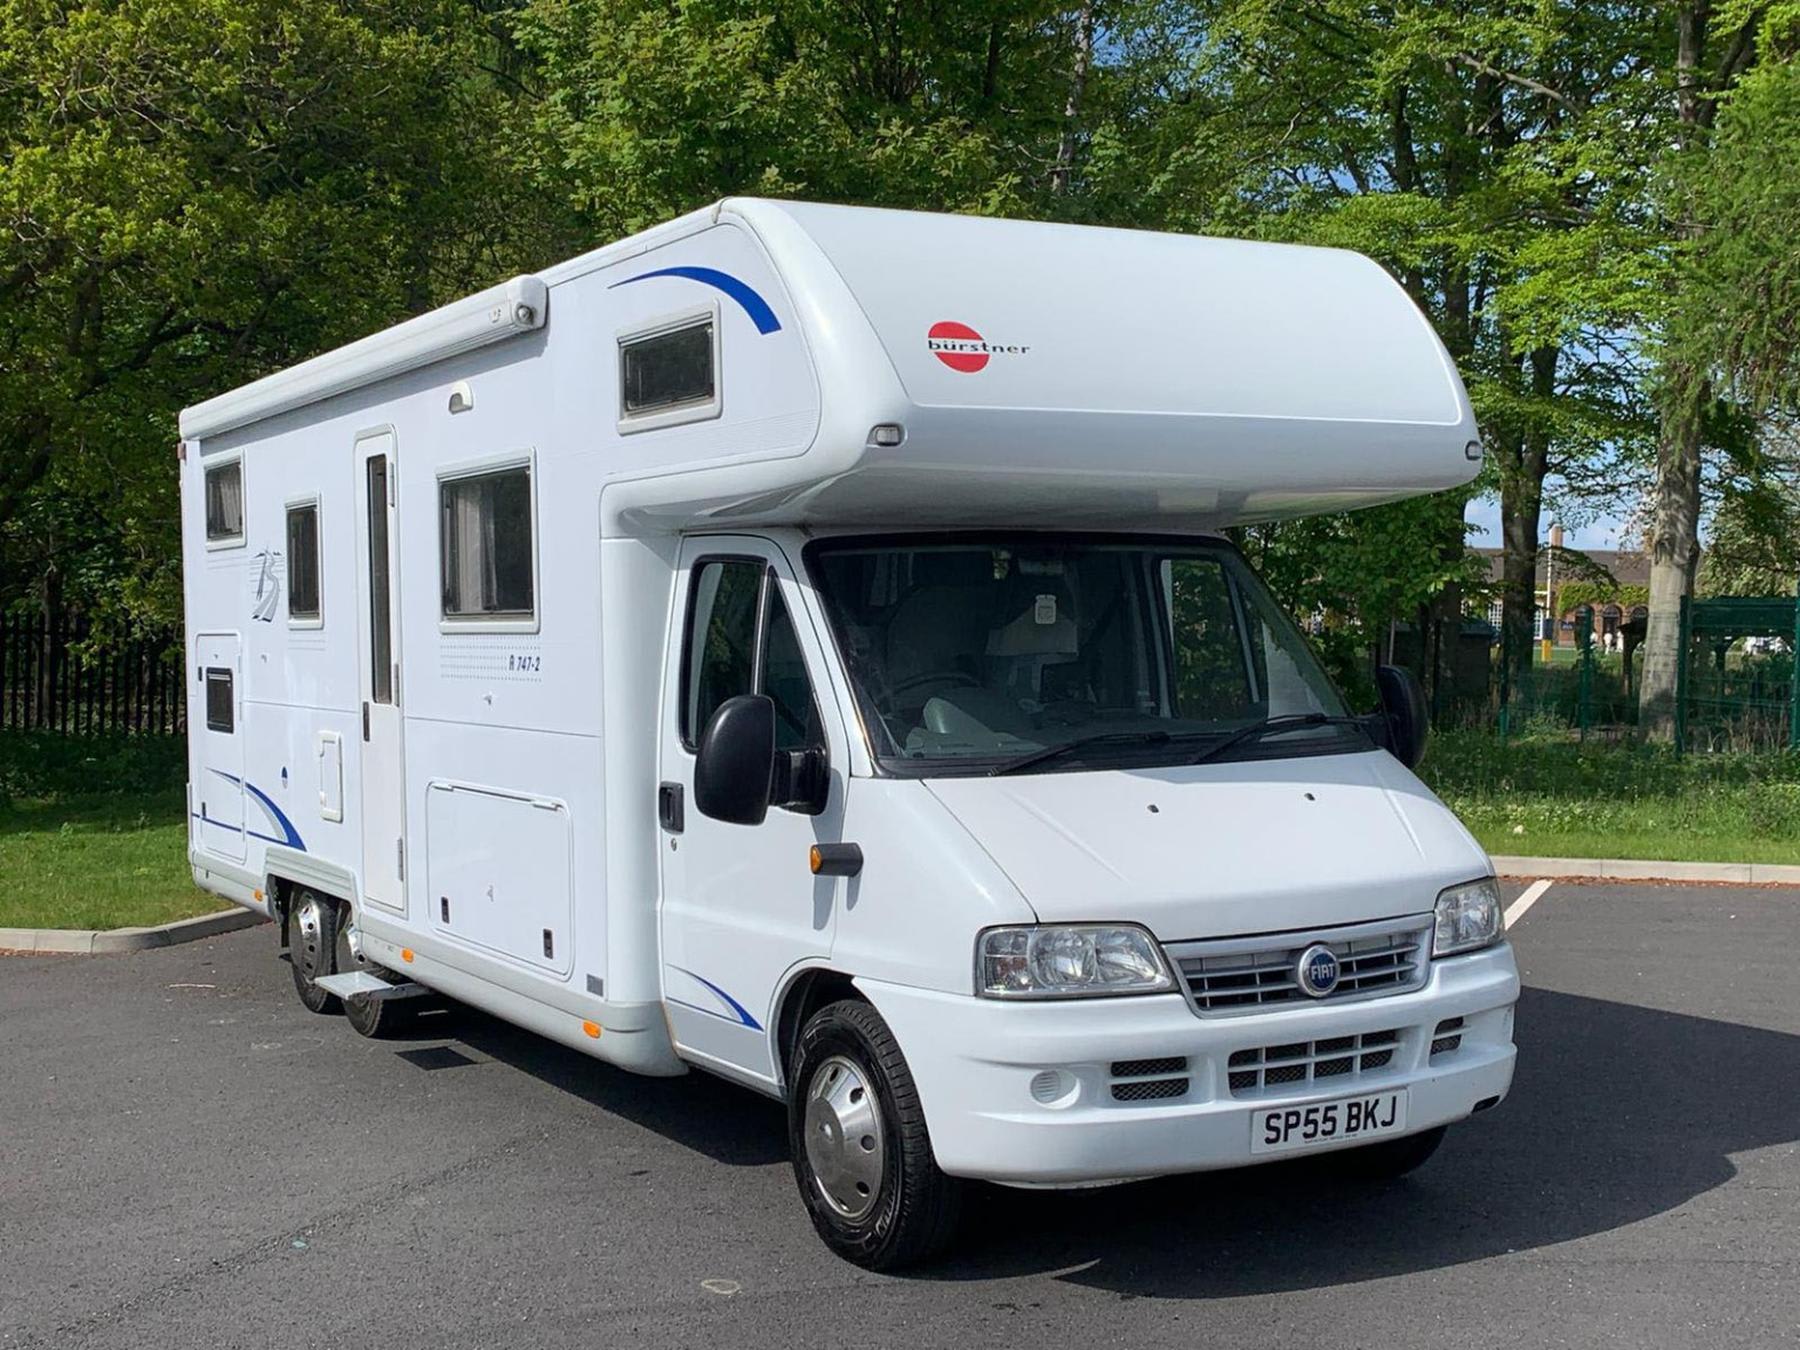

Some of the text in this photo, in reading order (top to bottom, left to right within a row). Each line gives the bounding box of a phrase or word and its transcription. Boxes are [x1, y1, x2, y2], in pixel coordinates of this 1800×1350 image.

[928, 340, 1031, 354] bürstner
[517, 655, 541, 671] 747-2
[1311, 961, 1335, 981] FIAT
[1264, 1096, 1397, 1145] SP55 BKJ
